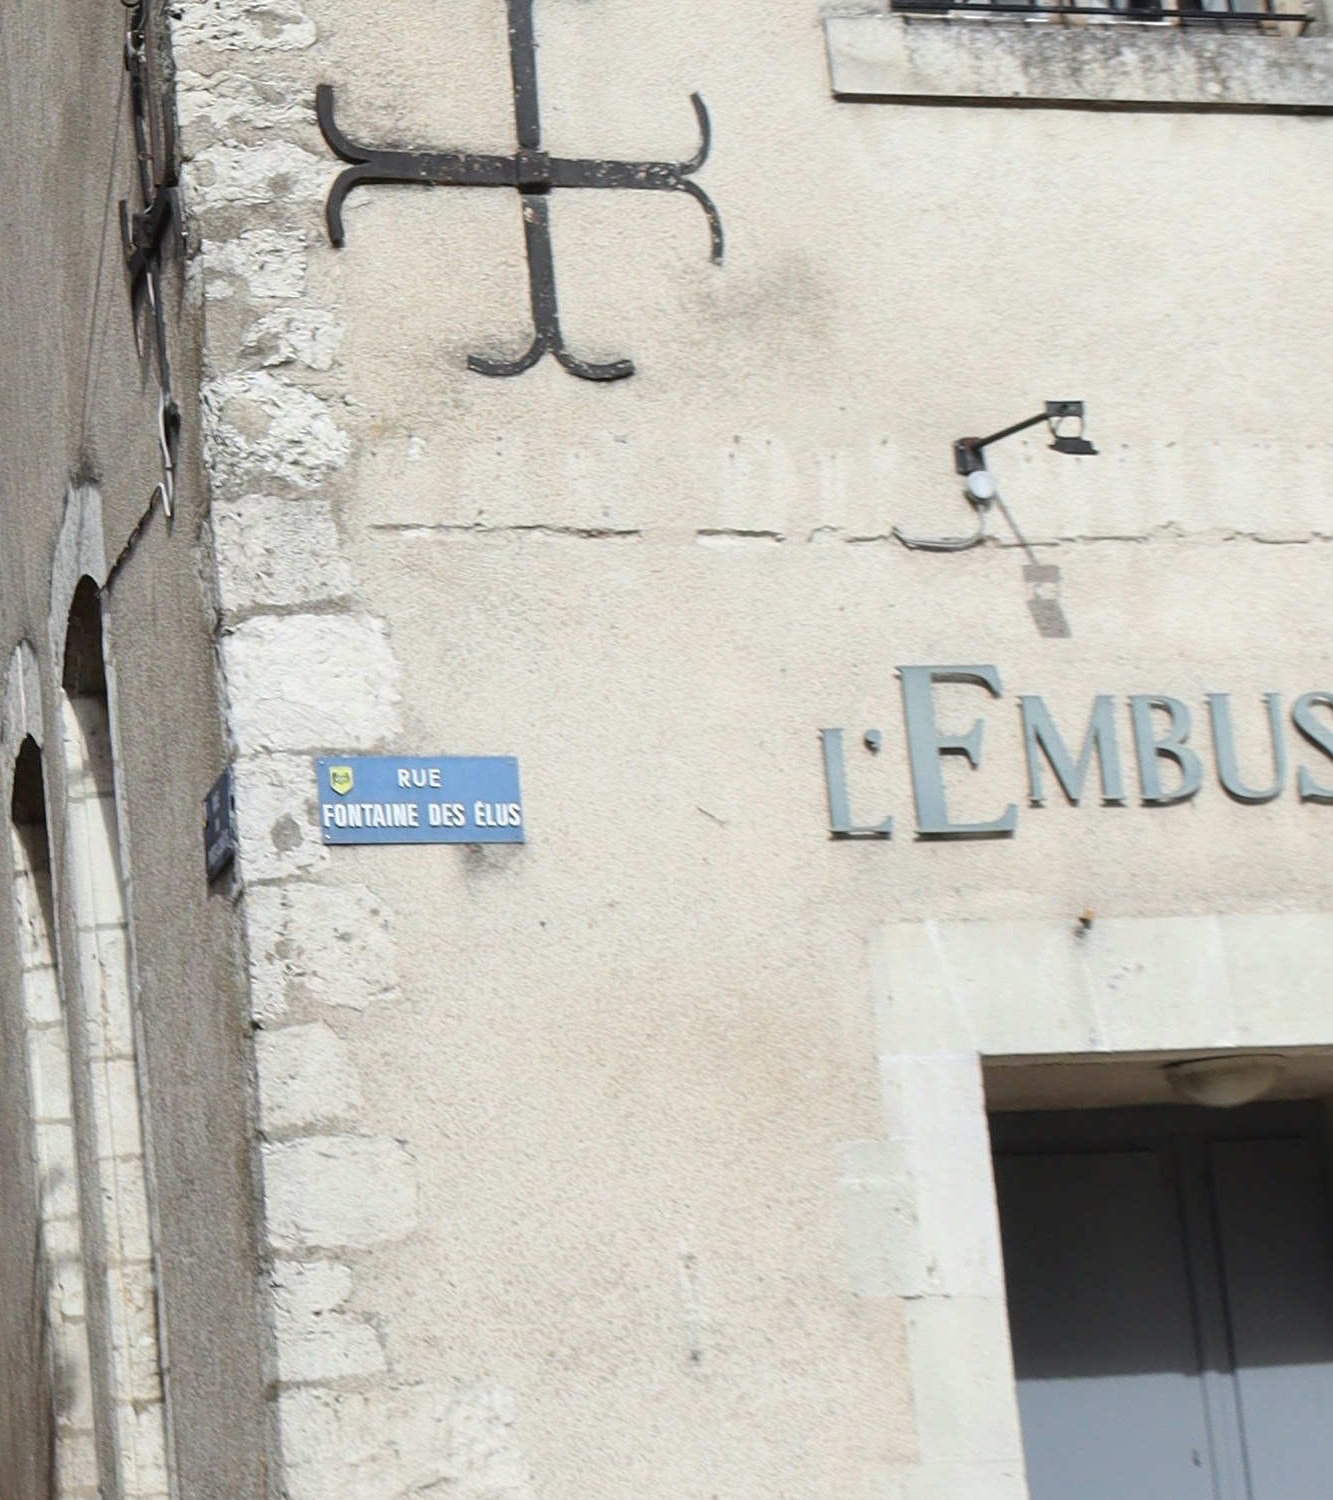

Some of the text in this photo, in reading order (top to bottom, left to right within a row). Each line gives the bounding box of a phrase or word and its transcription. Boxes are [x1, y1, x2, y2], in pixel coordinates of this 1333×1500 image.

[397, 768, 442, 787] RUE
[322, 803, 419, 828] FONTAINE
[428, 803, 465, 827] DES
